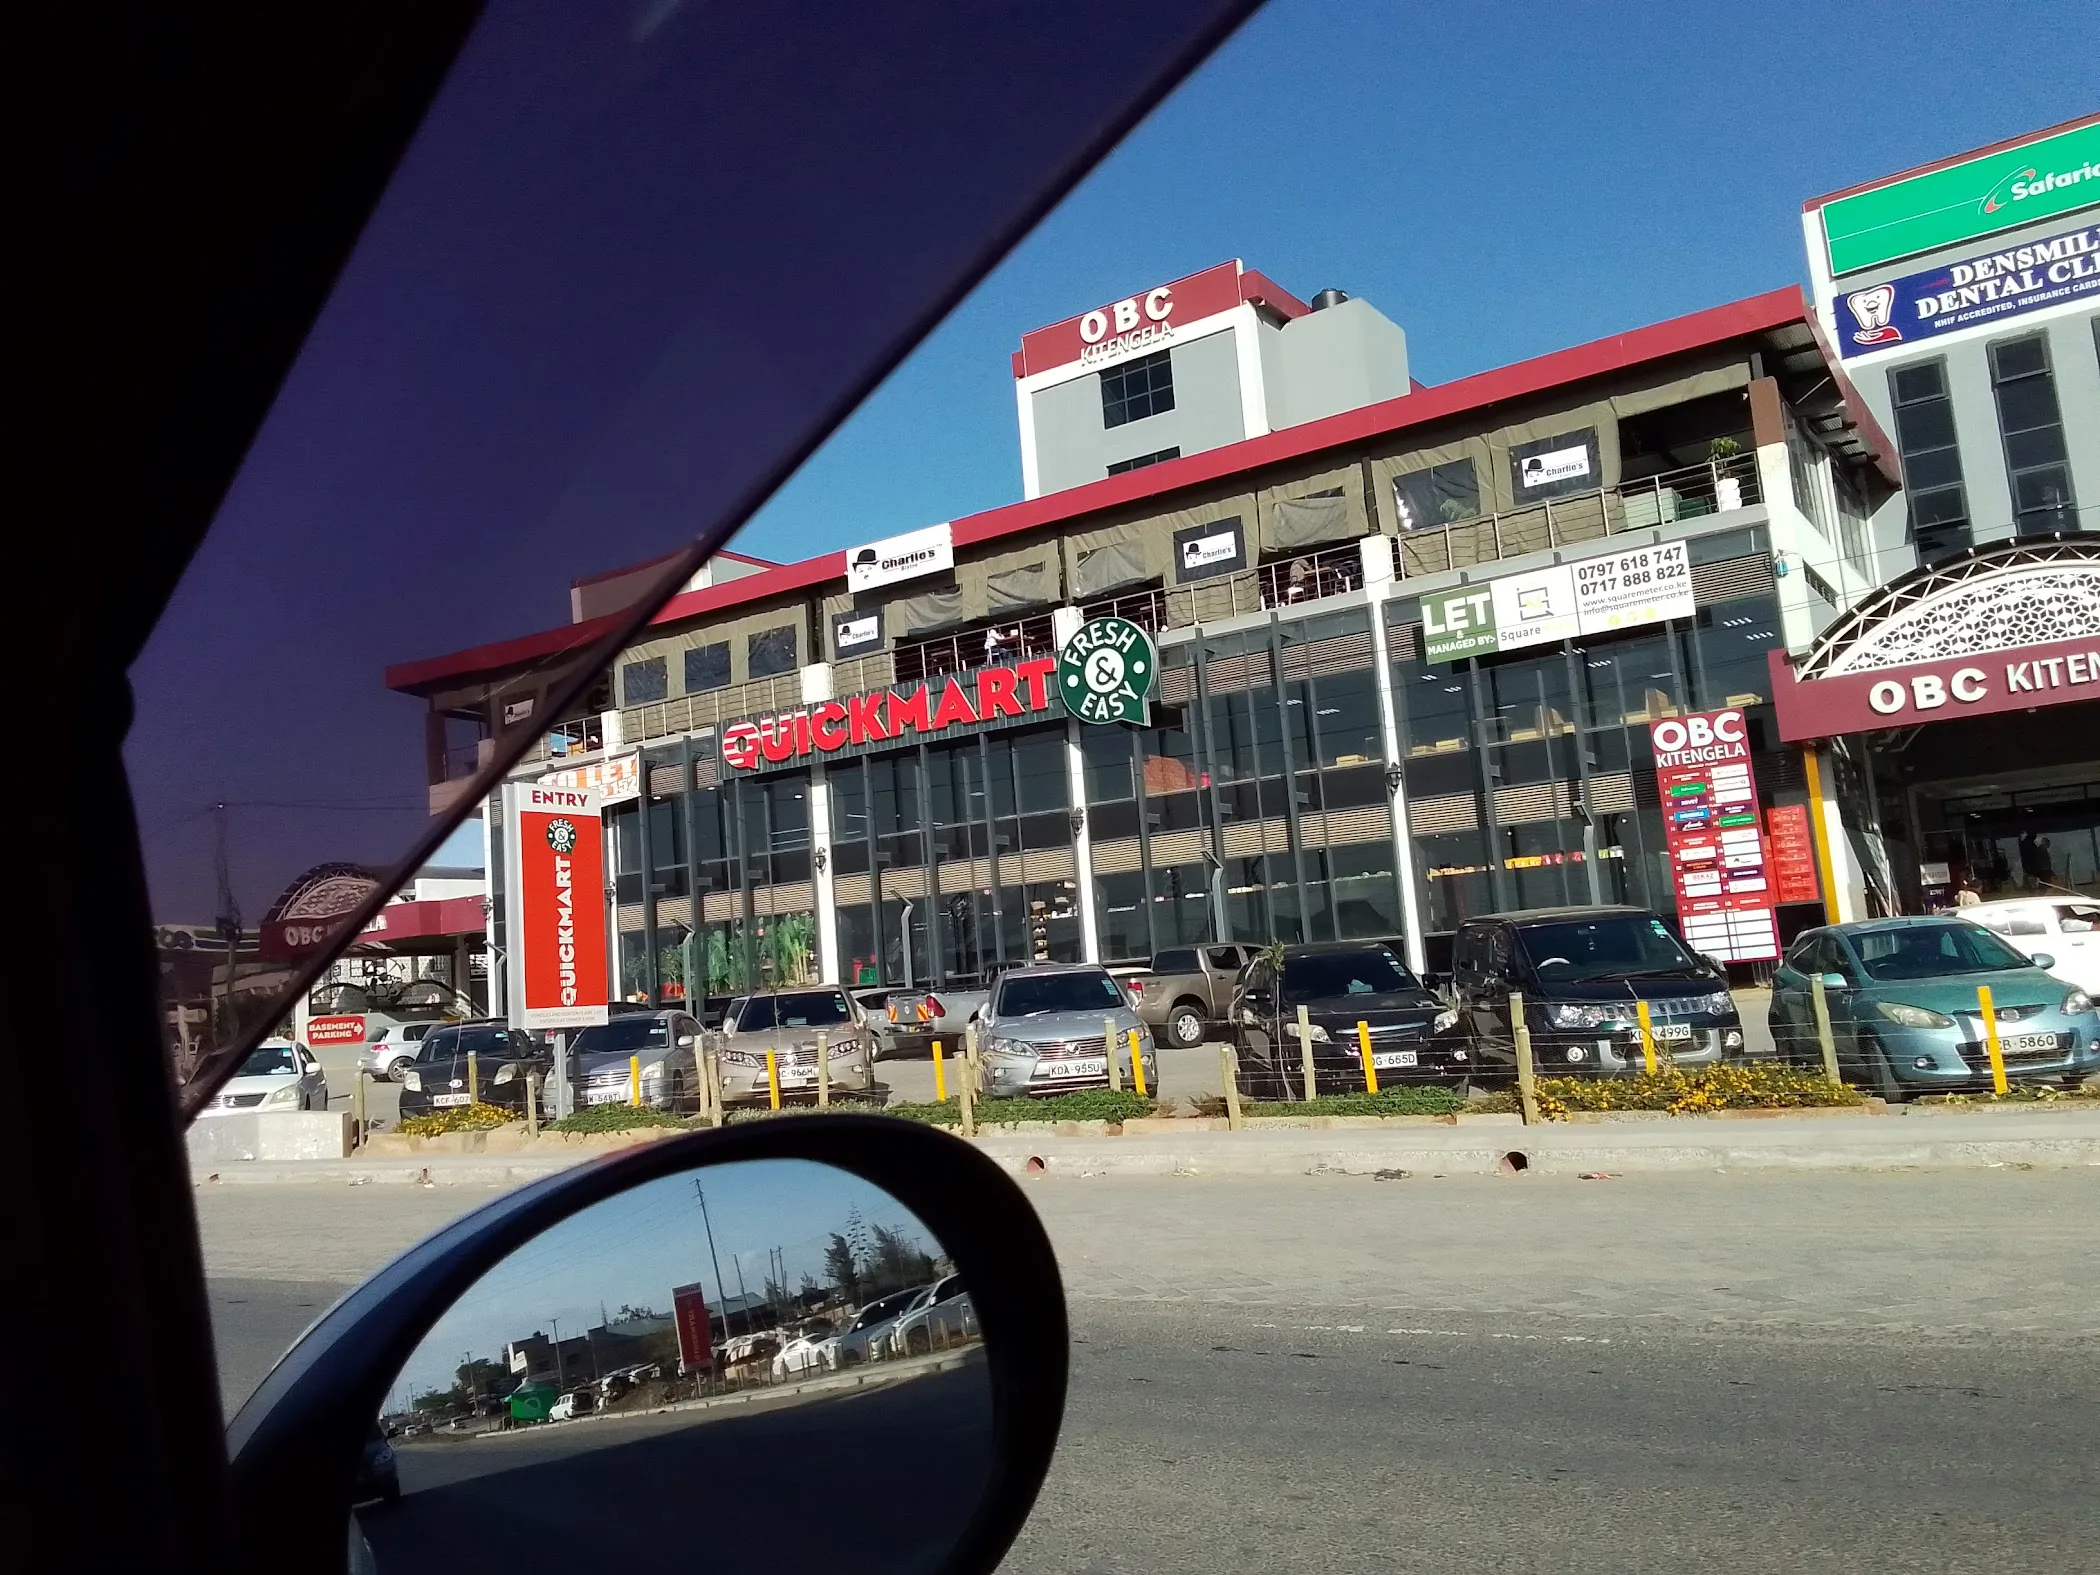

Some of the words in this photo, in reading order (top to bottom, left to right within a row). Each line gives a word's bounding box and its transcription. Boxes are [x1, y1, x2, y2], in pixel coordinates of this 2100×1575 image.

[1949, 228, 2100, 287] DENSMIL
[1915, 270, 2044, 320] DENTAL
[1934, 316, 1956, 329] NHIF
[1958, 301, 2017, 322] ACCREDITED,
[2018, 287, 2072, 307] INSURANCE
[1079, 286, 1175, 344] OBC
[1080, 320, 1176, 366] KITENGELA
[1546, 462, 1583, 477] Charlie's
[881, 549, 936, 570] Charlie's
[1203, 546, 1232, 559] Charlie's
[1578, 561, 1615, 580] 0797
[1620, 553, 1649, 571] 618
[1653, 546, 1682, 564] 747
[1580, 577, 1617, 596] 0717
[1623, 570, 1651, 587] 888
[1657, 563, 1686, 580] 822
[1583, 580, 1687, 607] www.squaremeter.co.ke
[1583, 590, 1689, 616] info@squaremeter.co.ke
[1421, 592, 1491, 636] LET
[1063, 621, 1138, 667] FRESH
[1427, 638, 1476, 656] MANAGED
[1457, 630, 1464, 639] &
[1095, 655, 1118, 686] &
[1079, 680, 1139, 720] EASY
[1869, 667, 1988, 714] OBC
[721, 657, 1057, 770] QUICKMART
[1653, 711, 1744, 752] OBC
[1656, 742, 1746, 768] KITENGELA
[531, 790, 588, 807] ENTRY
[548, 818, 574, 832] FRESH
[551, 841, 573, 852] EASY
[285, 925, 325, 947] OBC
[555, 855, 578, 1007] QUICKMART
[309, 1022, 356, 1032] BASEMENT
[312, 1030, 353, 1040] PARKING
[1660, 1026, 1689, 1038] 499G
[1050, 1065, 1070, 1077] KDA
